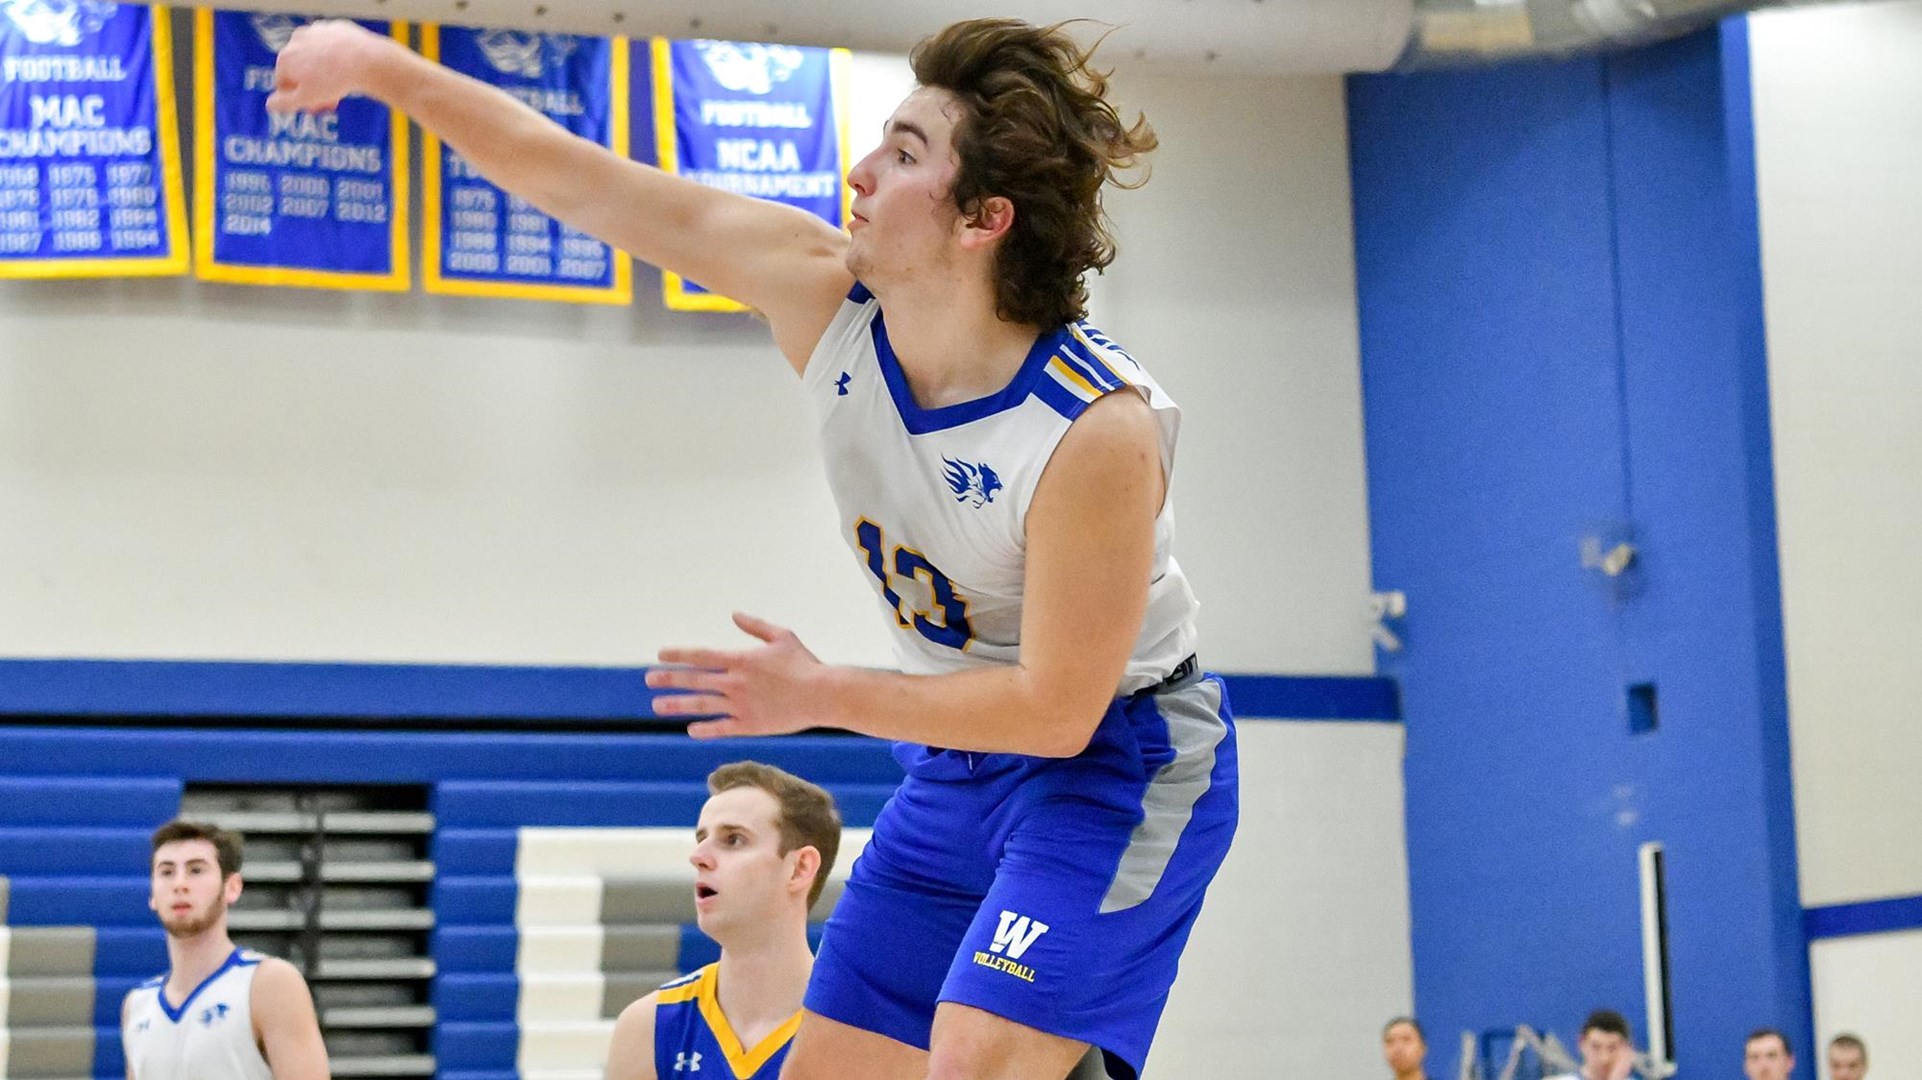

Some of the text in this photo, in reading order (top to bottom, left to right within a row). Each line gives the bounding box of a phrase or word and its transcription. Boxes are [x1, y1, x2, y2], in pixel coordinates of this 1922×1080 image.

[4, 56, 127, 82] FOOTBALL
[30, 94, 106, 129] MAC
[268, 110, 339, 140] MAC
[702, 101, 812, 129] FOOTBALL
[224, 136, 382, 173] CHAMPIONS
[716, 139, 801, 171] NCAA
[107, 163, 152, 186] 1977
[279, 175, 330, 197] 2000
[337, 180, 384, 201] 2001
[224, 193, 387, 223] 2002 2007 2012
[508, 213, 550, 233] 1981
[222, 213, 272, 235] 2014
[854, 516, 976, 654] 13
[989, 910, 1050, 959] W
[973, 951, 1036, 983] VOLLEYBALL
